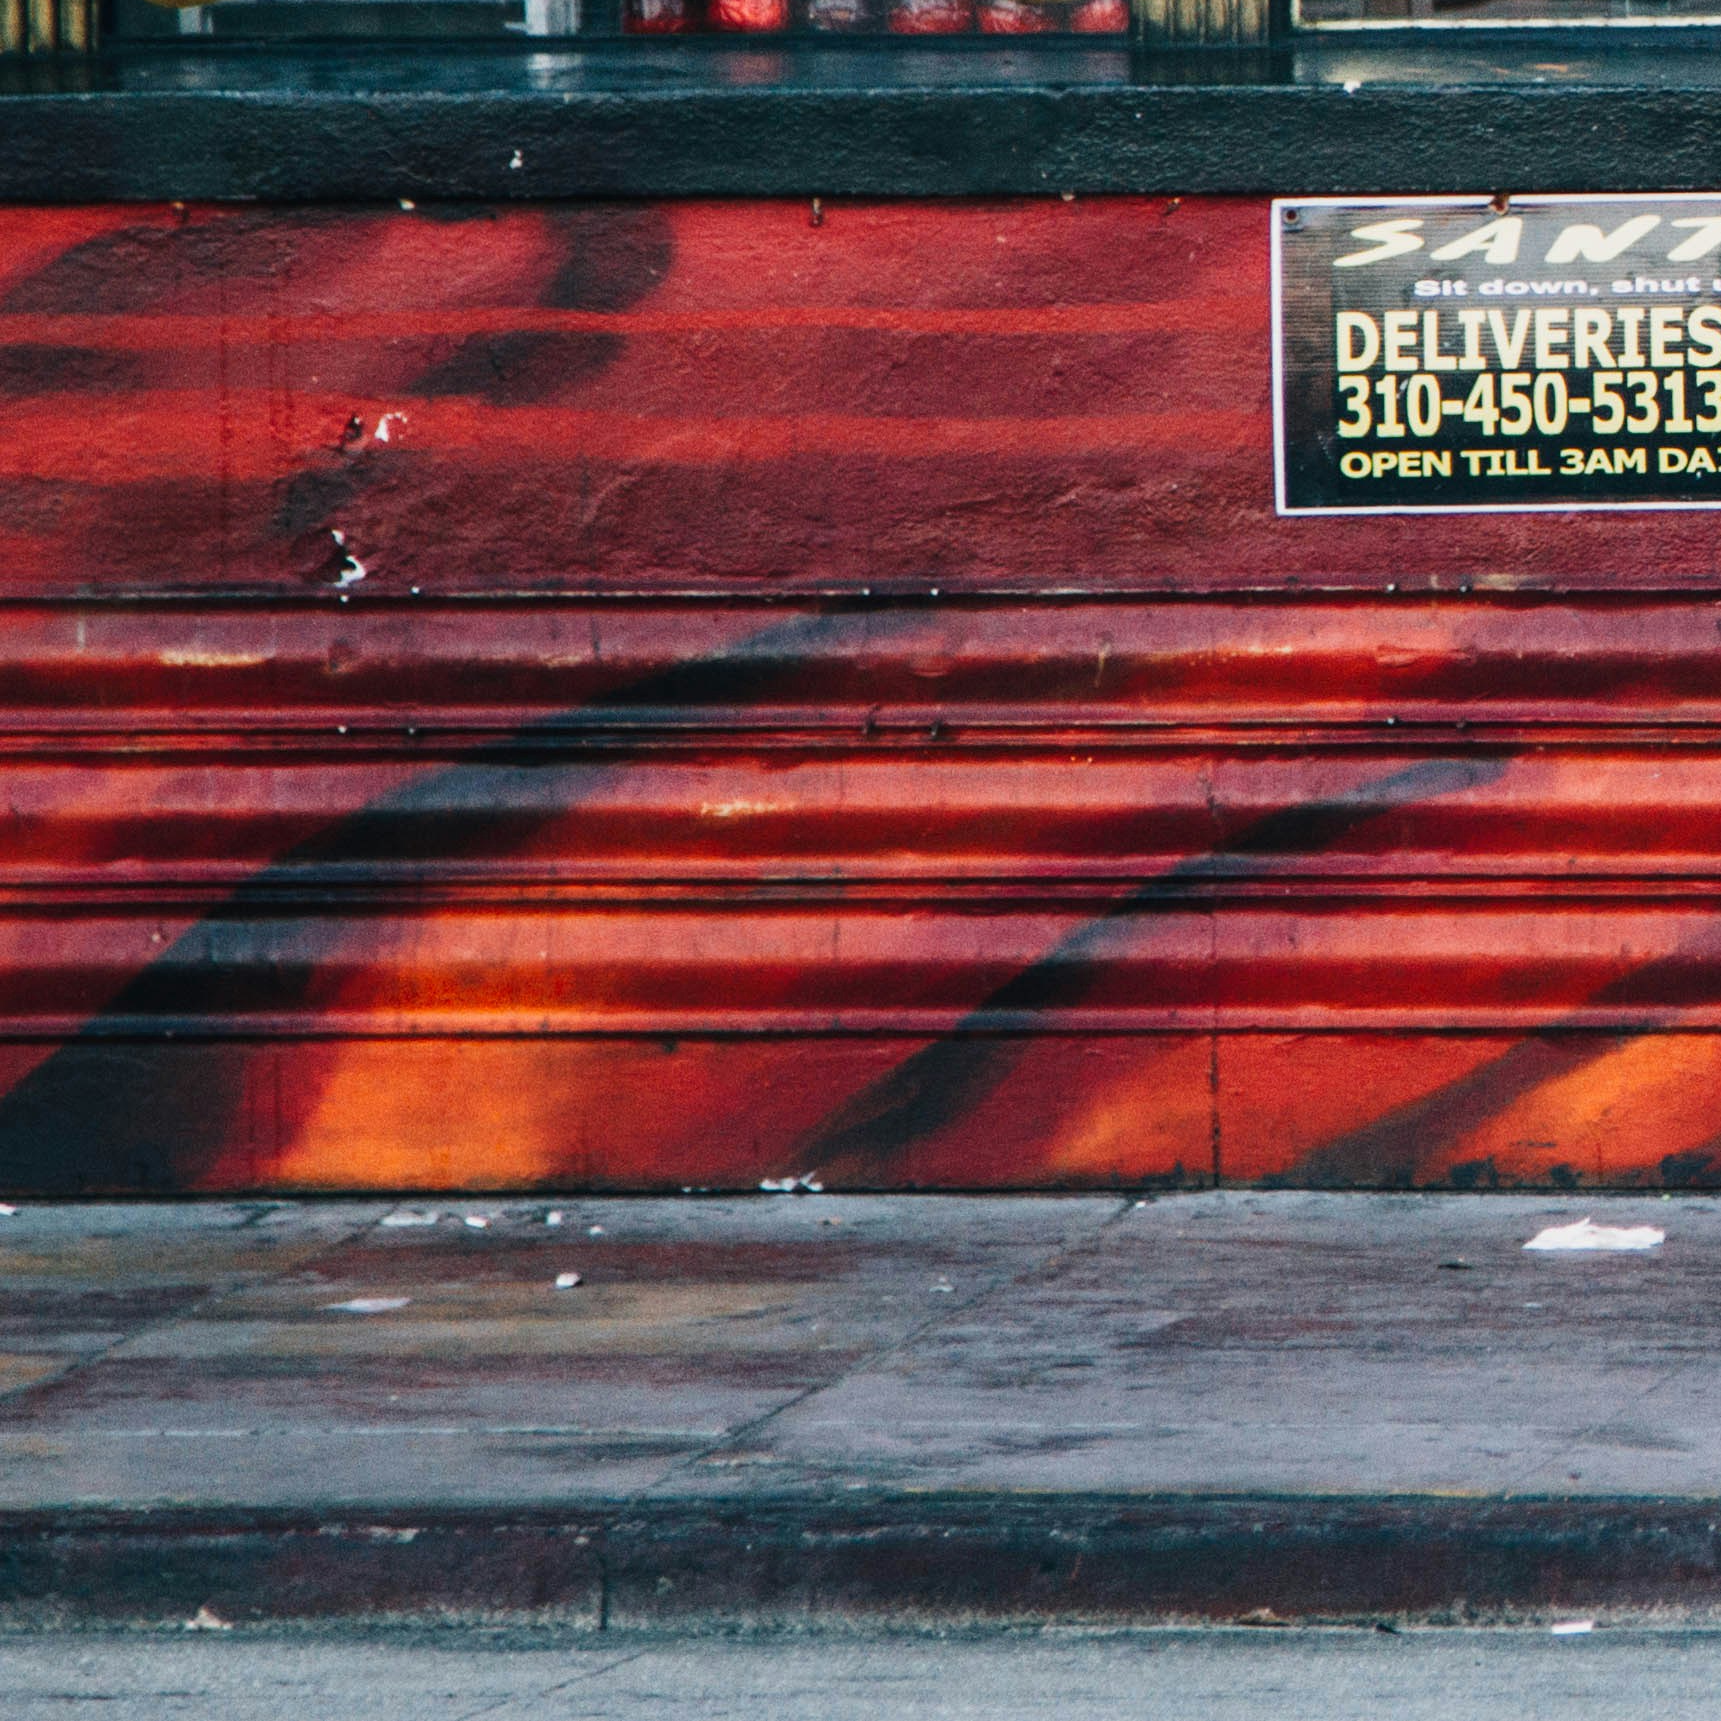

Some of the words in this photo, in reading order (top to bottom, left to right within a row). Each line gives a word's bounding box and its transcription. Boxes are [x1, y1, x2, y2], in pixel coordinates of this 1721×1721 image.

[1413, 279, 1469, 298] Sit
[1478, 277, 1599, 297] down,
[1610, 276, 1701, 295] shut
[1340, 449, 1452, 480] OPEN
[1460, 448, 1552, 478] TILL
[1560, 446, 1648, 476] 3AM
